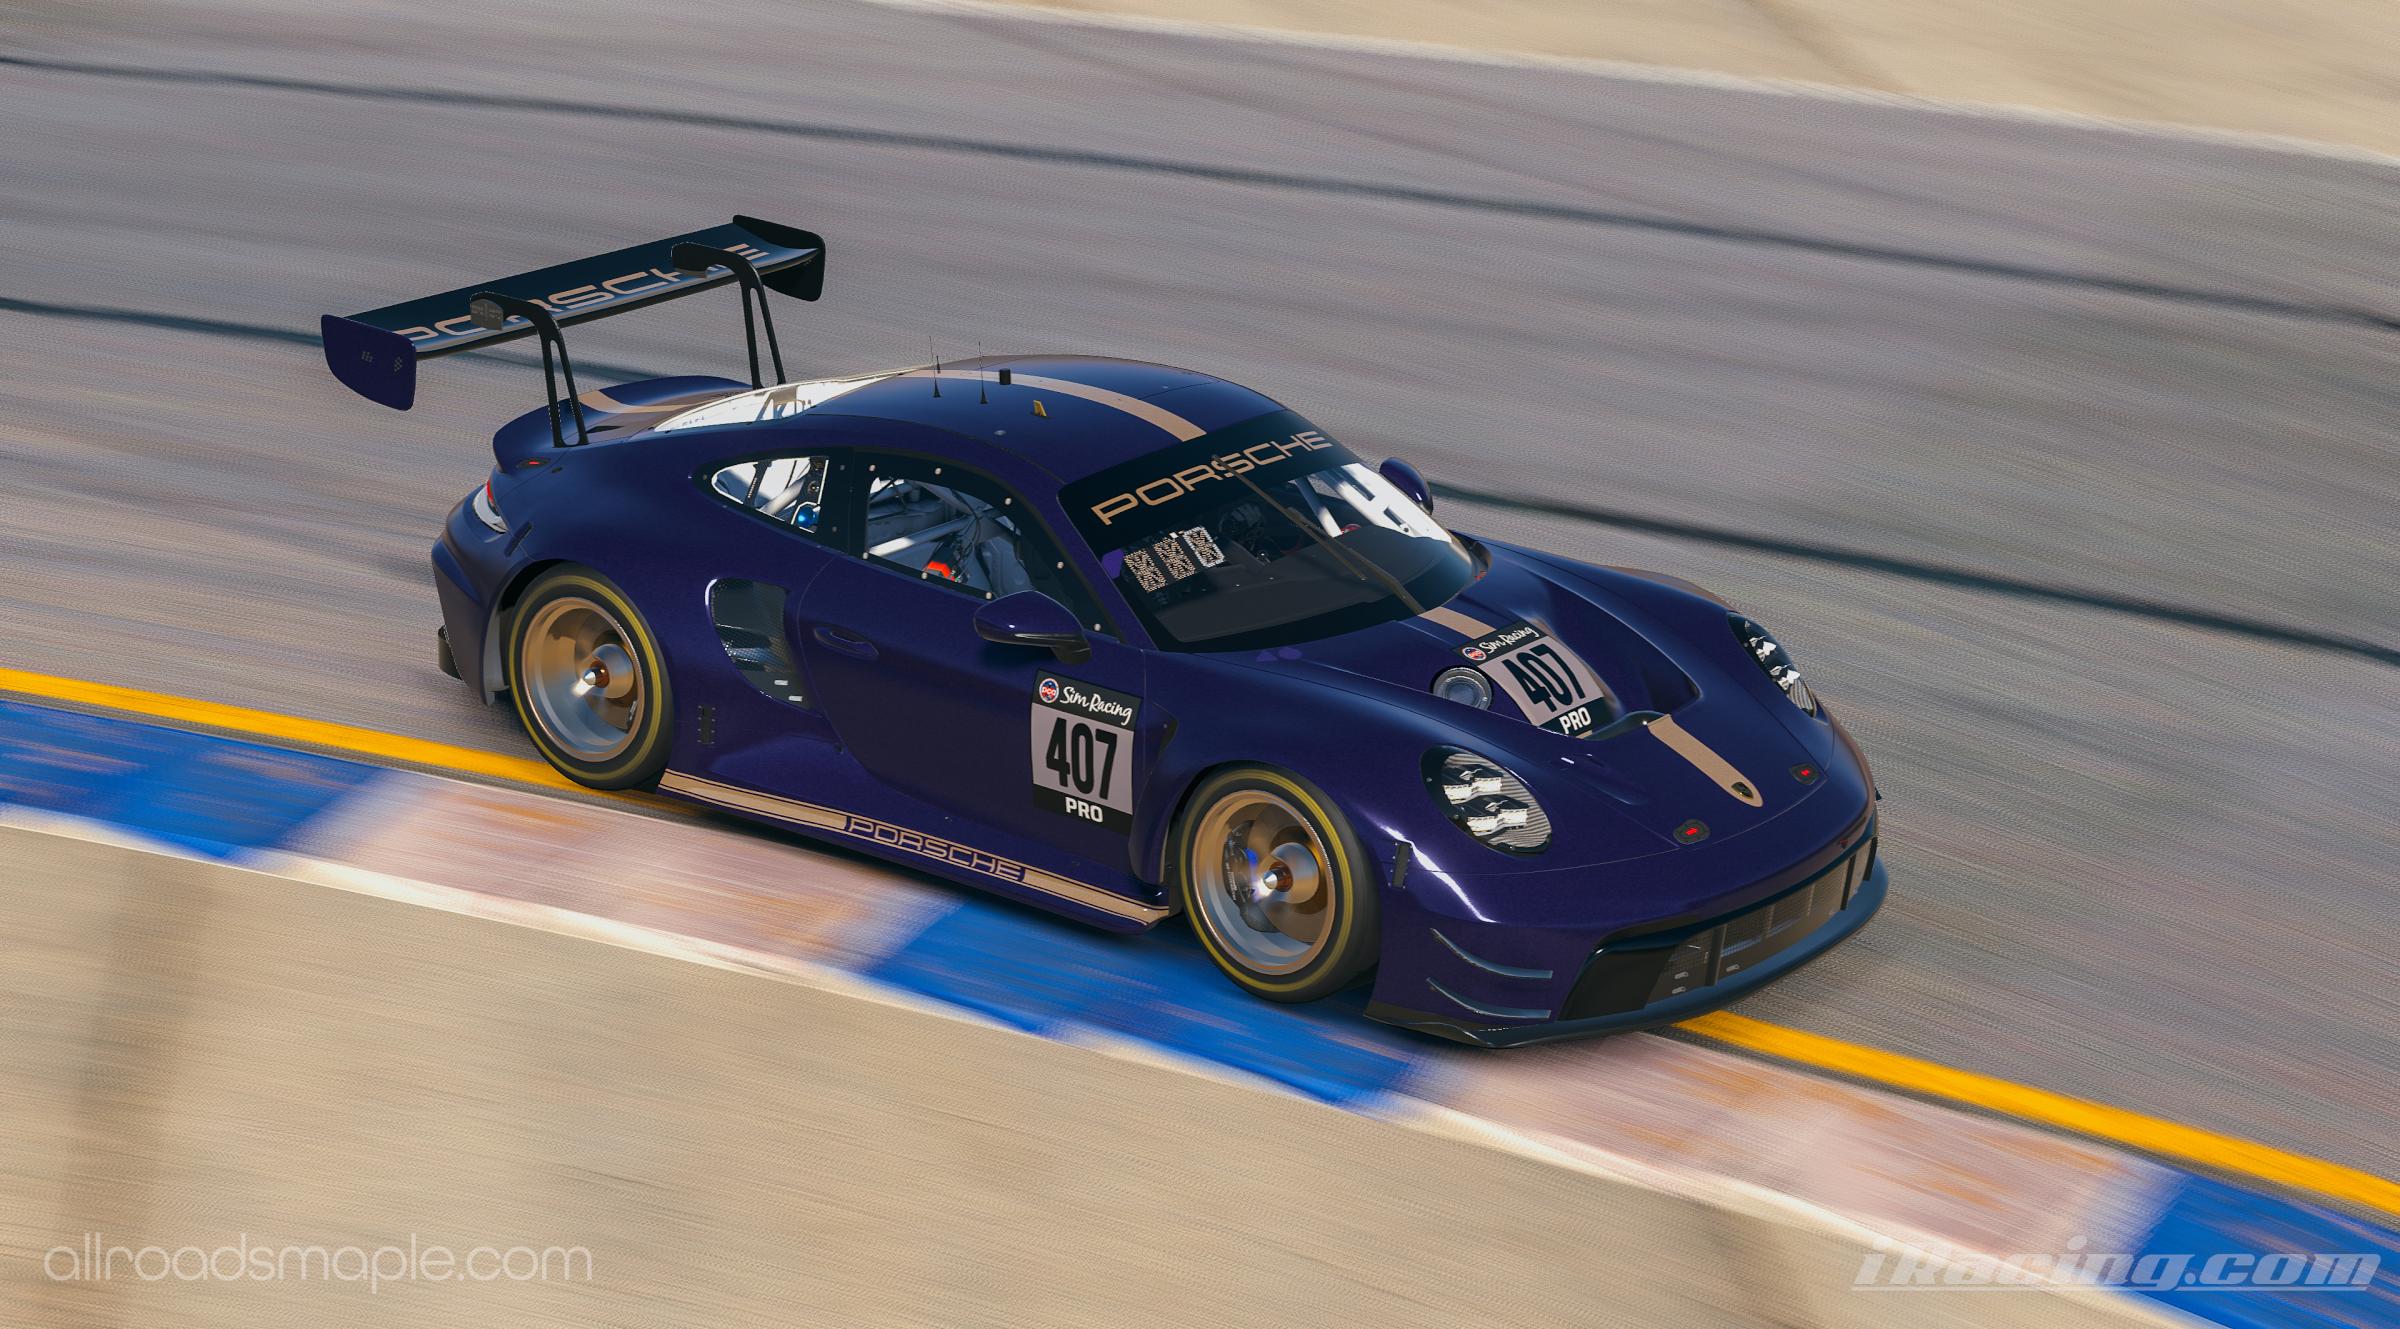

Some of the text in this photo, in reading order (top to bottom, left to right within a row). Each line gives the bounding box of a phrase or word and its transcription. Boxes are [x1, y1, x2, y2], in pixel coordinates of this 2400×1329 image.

[1091, 431, 1333, 526] PORSCHE
[1479, 638, 1504, 654] Sim
[1501, 626, 1540, 644] Racing
[1502, 643, 1586, 713] 407
[1060, 686, 1133, 726] Sim Racing
[1559, 706, 1592, 735] PRO
[1046, 717, 1118, 800] 407
[1065, 796, 1104, 823] PRO
[848, 817, 1022, 881] PORSCHE
